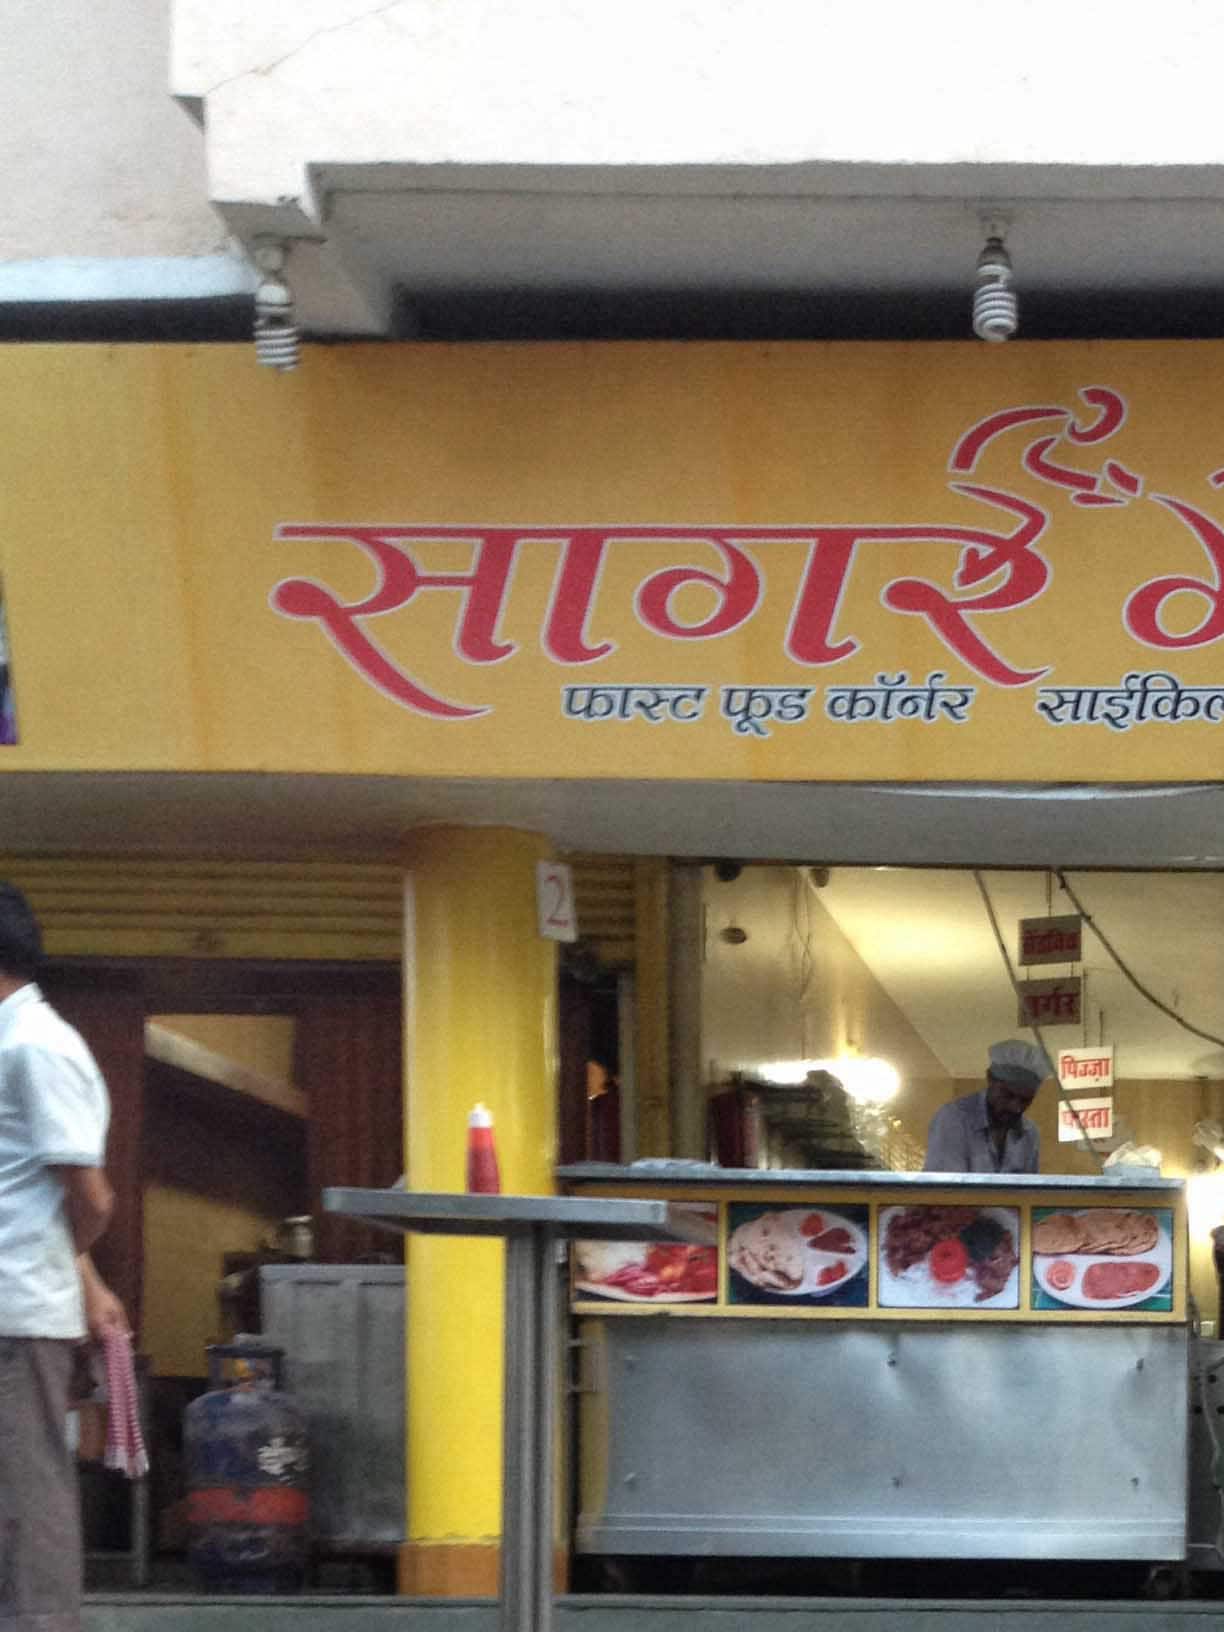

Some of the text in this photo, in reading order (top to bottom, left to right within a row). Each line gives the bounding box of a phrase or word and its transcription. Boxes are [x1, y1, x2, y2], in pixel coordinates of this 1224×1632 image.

[268, 480, 1053, 719] सागर
[563, 684, 706, 722] फास्ट
[721, 684, 813, 736] फूड
[826, 674, 977, 722] कॉर्नर
[546, 873, 568, 929] 2
